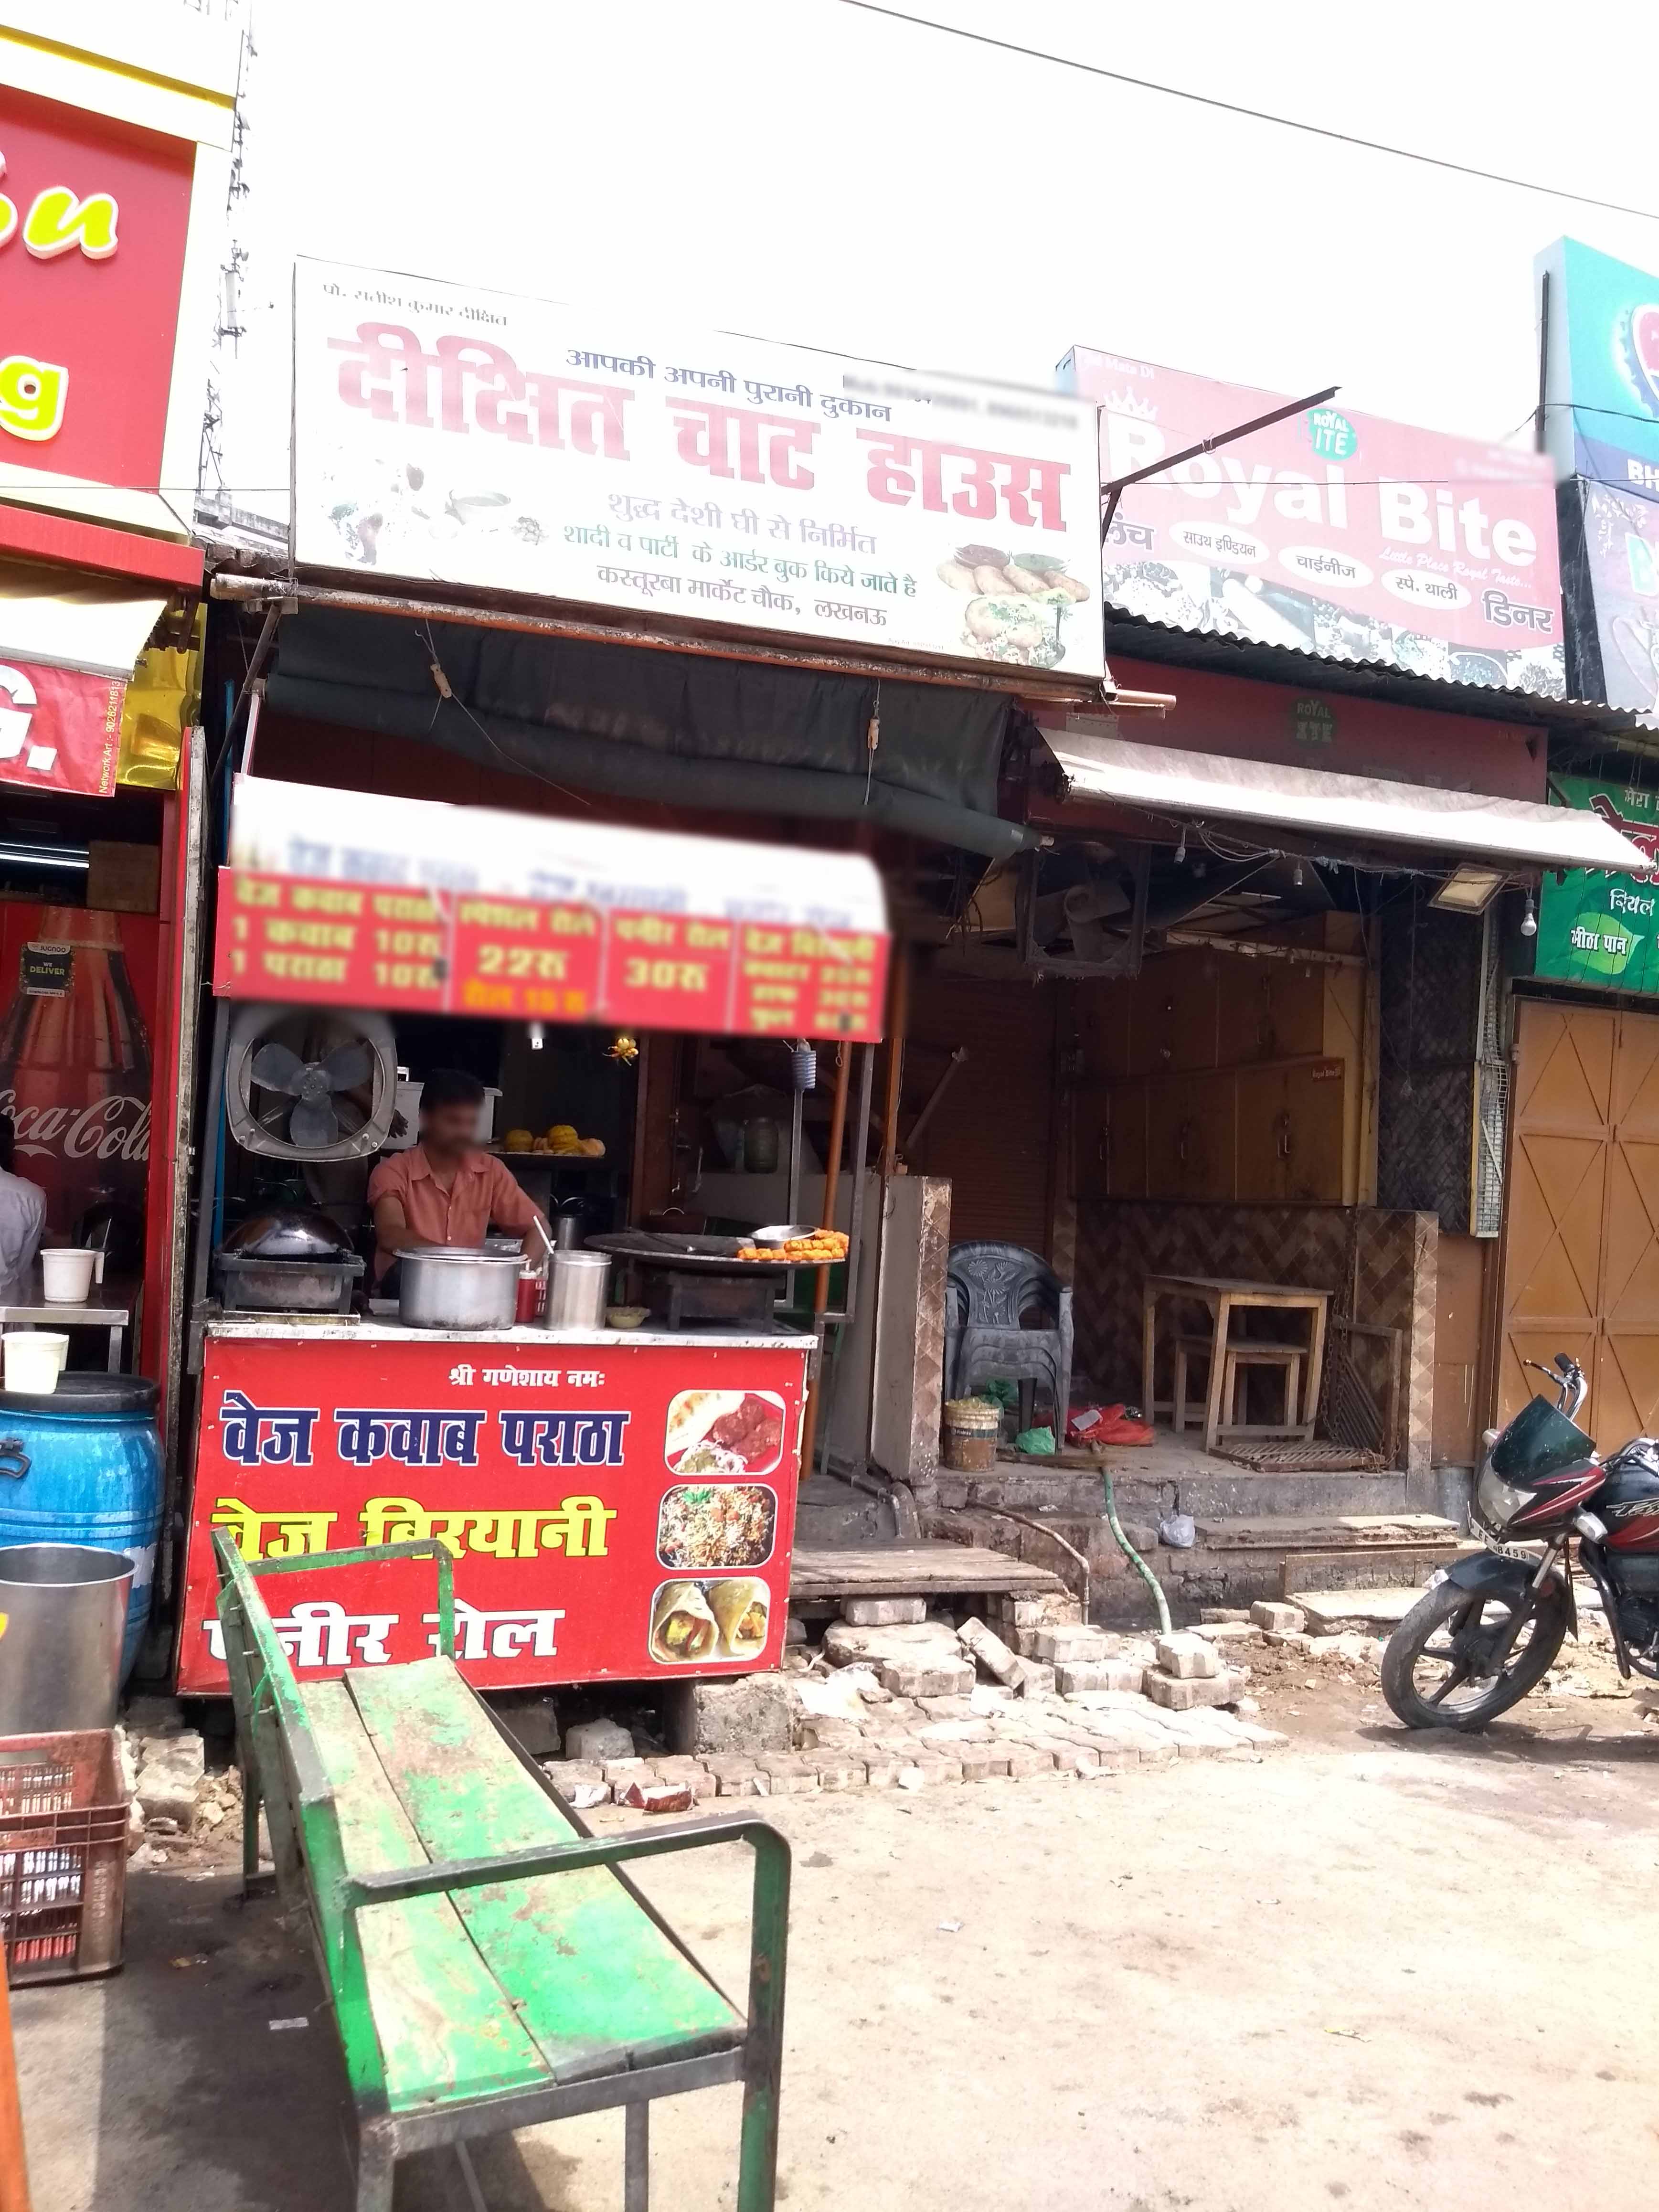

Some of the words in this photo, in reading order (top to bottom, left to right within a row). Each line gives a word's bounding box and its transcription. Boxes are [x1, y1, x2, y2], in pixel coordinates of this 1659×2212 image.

[408, 300, 453, 316] कुमार
[566, 349, 655, 379] आपकी
[664, 366, 736, 393] अपनी
[744, 380, 812, 407] पुरानी
[820, 394, 892, 422] दुकान
[327, 321, 635, 461] दीक्षित
[666, 396, 821, 490] चाट
[856, 428, 1071, 532] हाउस
[1313, 411, 1349, 433] ROYAL
[1108, 411, 1349, 530] Royal
[1378, 476, 1536, 567] Bite
[608, 492, 661, 522] शुद्ध
[670, 498, 722, 528] देशी
[731, 508, 759, 535] घी
[766, 514, 791, 540] से
[799, 518, 877, 554] निर्मित
[1183, 530, 1212, 549] साउथ
[564, 524, 610, 548] शादी
[617, 533, 632, 552] व
[692, 541, 713, 563] के
[774, 558, 808, 583] बुक
[814, 560, 854, 587] किये
[861, 572, 898, 594] जाते
[1295, 553, 1357, 579] चाईनीज
[597, 565, 681, 597] कस्तूरबा
[814, 599, 887, 626] लखनऊ
[1425, 582, 1457, 600] थाली
[1481, 589, 1554, 633] डिनर
[103, 741, 113, 757] Art
[99, 757, 111, 794] Network
[1571, 925, 1600, 950] मीठा
[1603, 935, 1628, 955] पान
[30, 966, 65, 976] DELIVER
[449, 1364, 477, 1386] श्री
[481, 1364, 562, 1387] गणेशाय
[566, 1370, 605, 1387] नमः
[218, 1389, 320, 1468] वेज
[332, 1408, 488, 1468] कवाब
[499, 1410, 632, 1468] पराठा
[210, 1496, 339, 1561] वेज
[358, 1495, 618, 1560] बिरयानी
[1497, 1546, 1527, 1559] 8459
